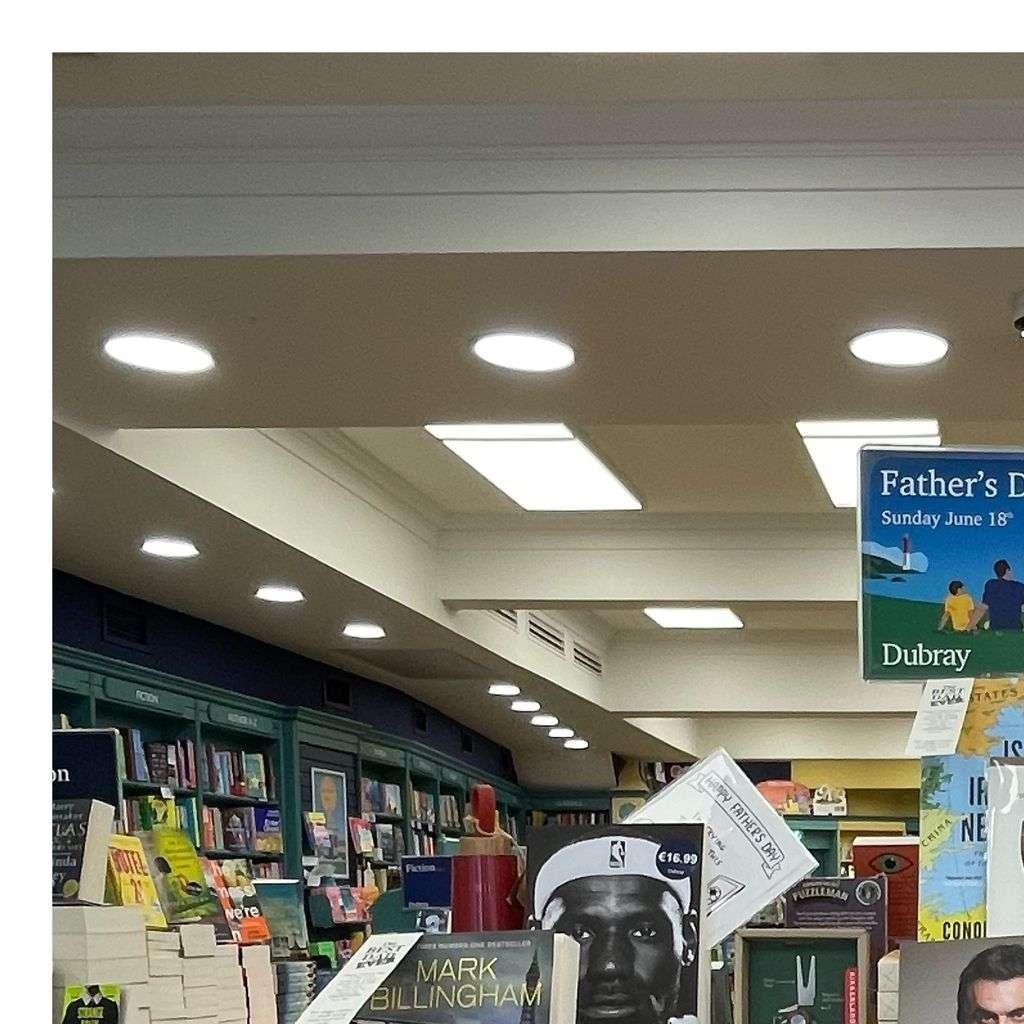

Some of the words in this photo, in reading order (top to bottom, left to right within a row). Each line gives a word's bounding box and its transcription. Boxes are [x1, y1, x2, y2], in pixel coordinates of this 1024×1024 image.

[880, 469, 998, 499] Father's
[881, 510, 941, 528] Sunday
[944, 511, 982, 527] June
[881, 643, 971, 672] Dubray
[416, 957, 499, 983] MARK
[369, 981, 544, 1011] BILLINGHAM
